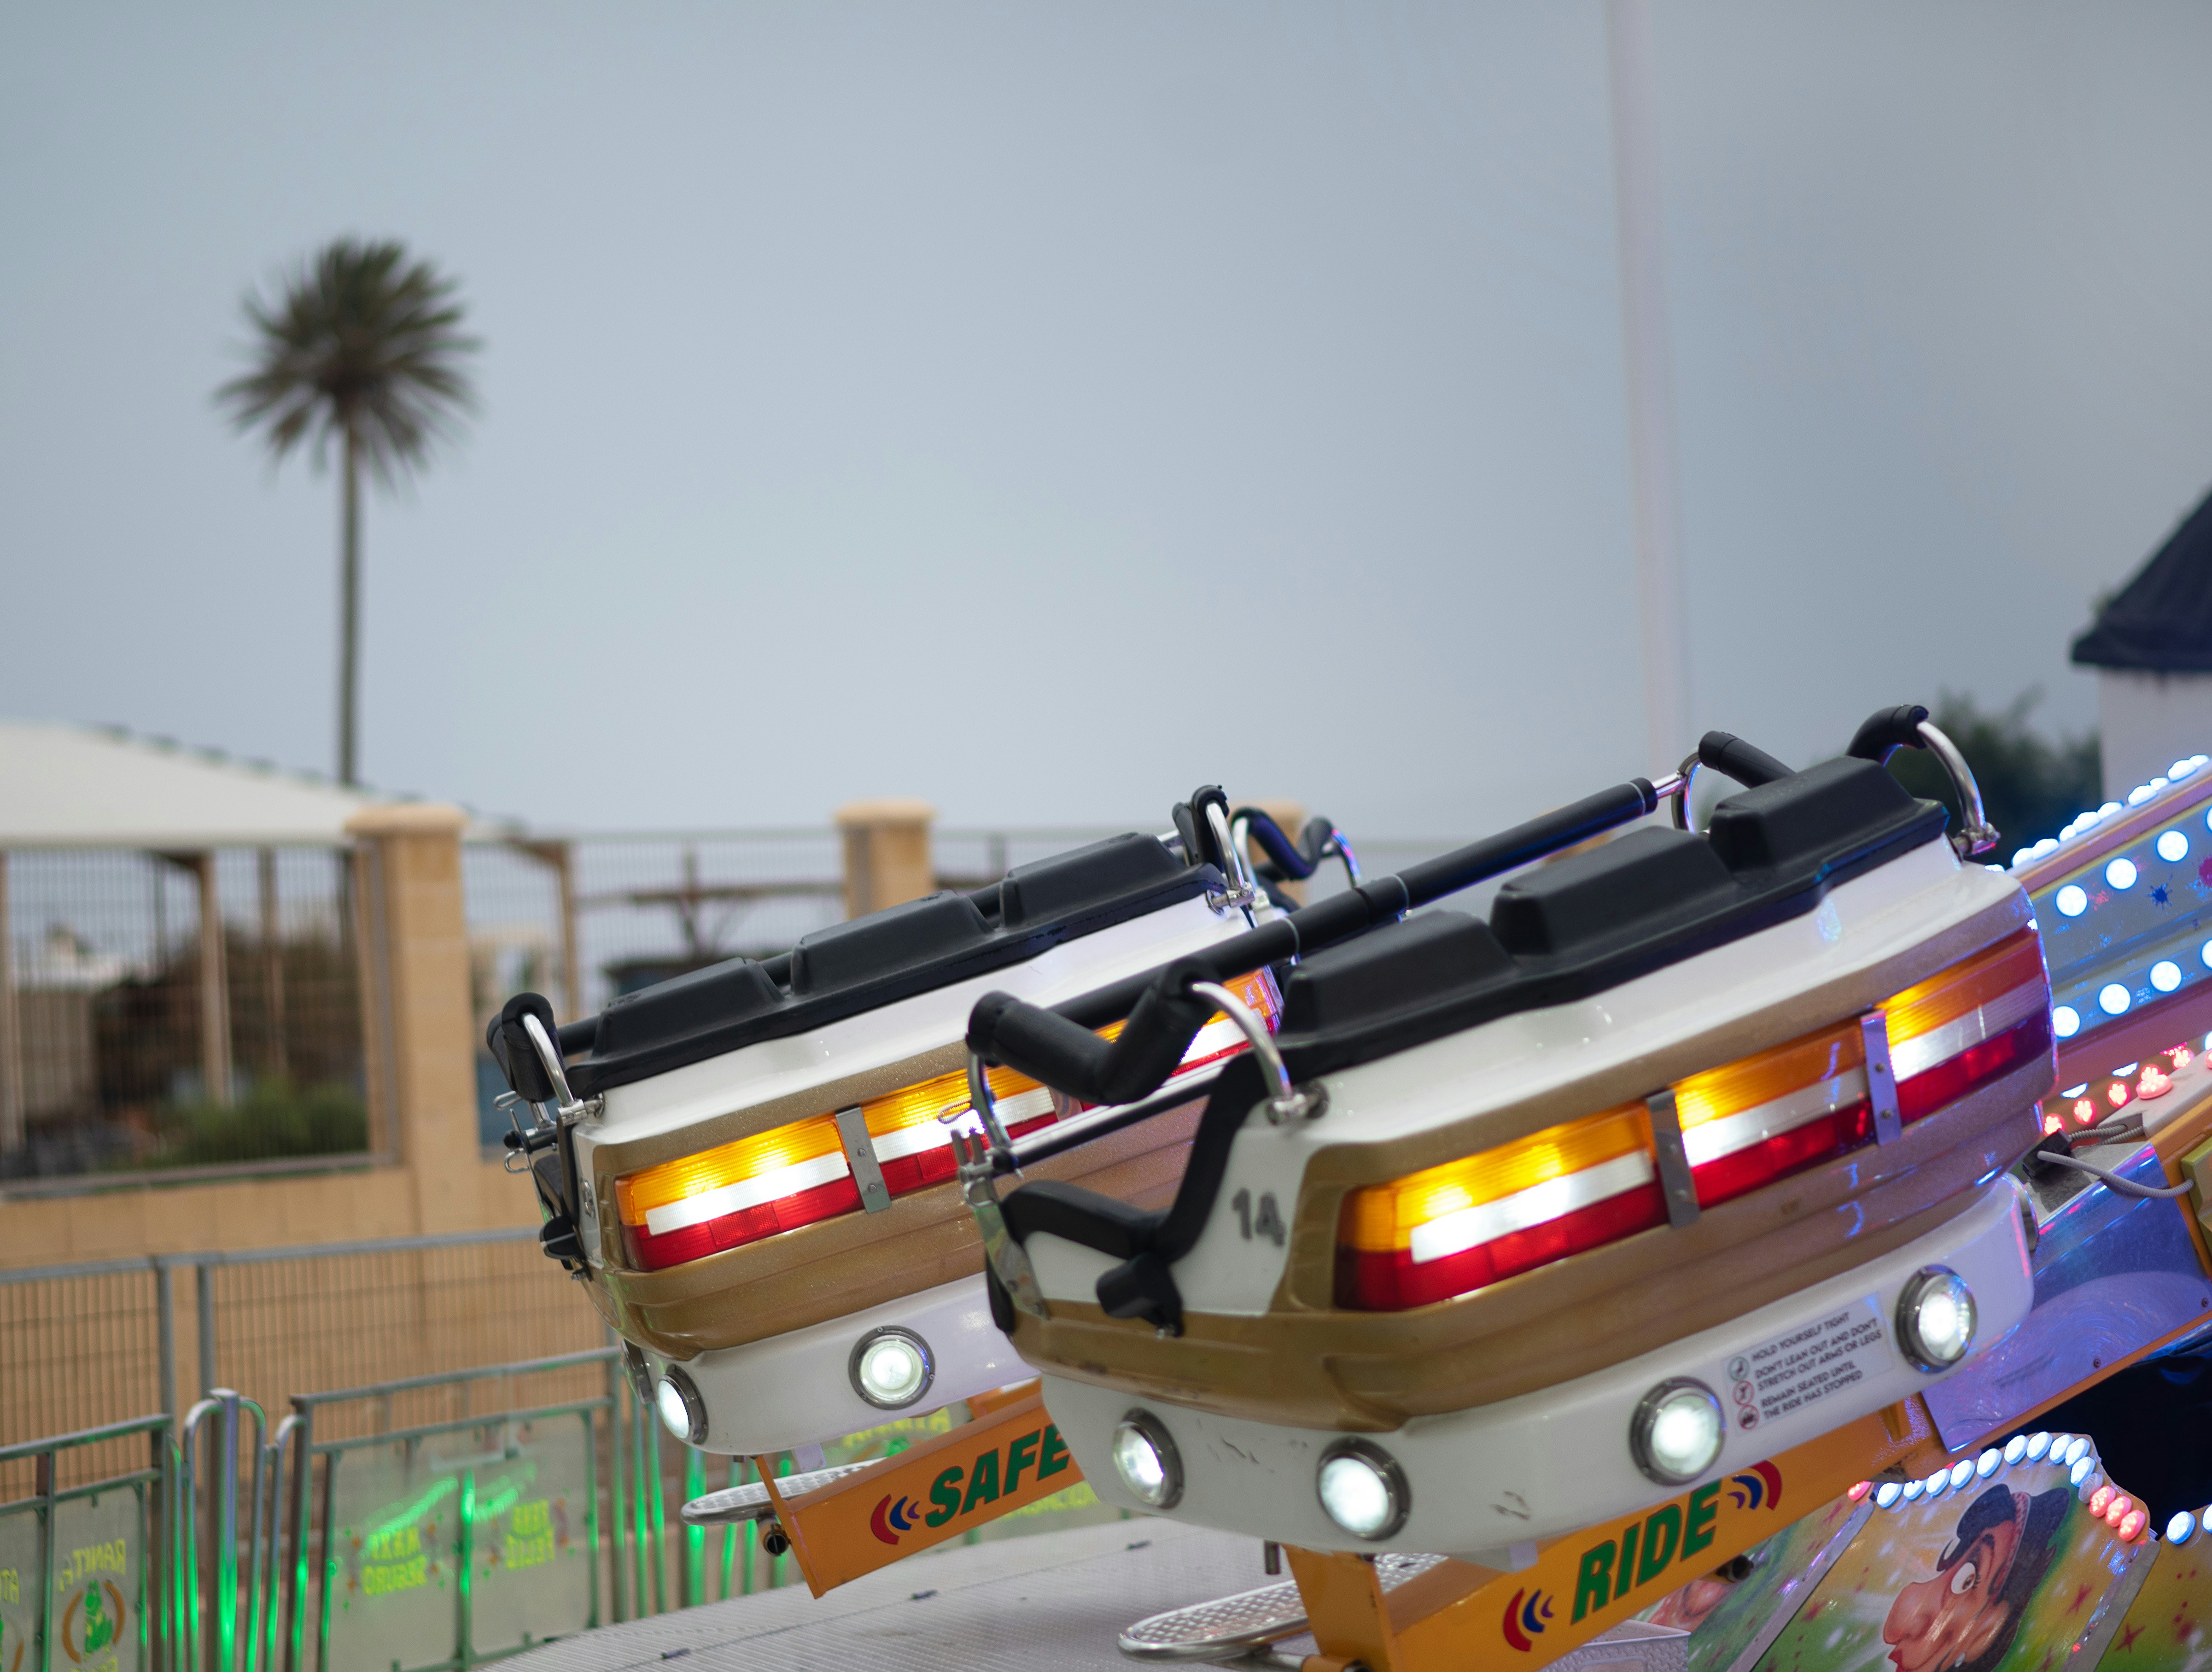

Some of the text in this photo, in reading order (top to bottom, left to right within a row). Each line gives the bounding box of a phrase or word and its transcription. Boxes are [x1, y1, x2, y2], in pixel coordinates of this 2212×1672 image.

[1232, 1187, 1287, 1249] 14
[1752, 1312, 1850, 1362] HOLD YOURSELF TIGHT
[1755, 1317, 1877, 1379] DON'T LEAN OUT AND DON'T
[1757, 1329, 1882, 1391] STRETCH OUT ARMS OR LEGS
[1761, 1360, 1856, 1408] REMAIN SEATED UNTIL
[1763, 1369, 1863, 1420] THE RIDE HAS STOPPED
[925, 1424, 1070, 1527] SAFE
[1570, 1479, 1722, 1626] RIDE
